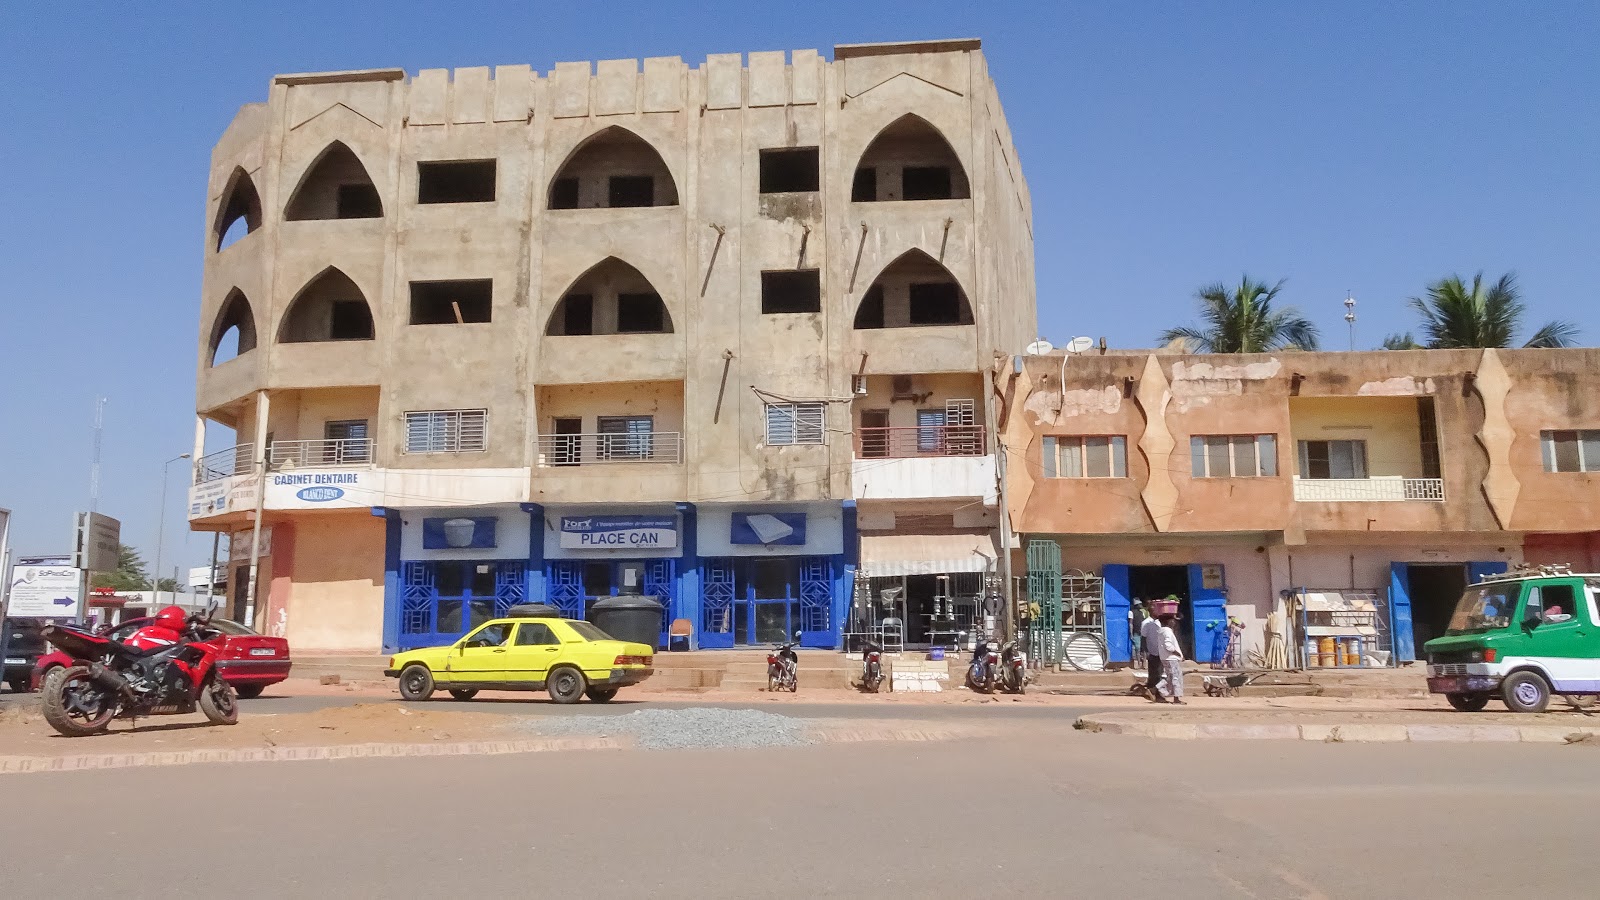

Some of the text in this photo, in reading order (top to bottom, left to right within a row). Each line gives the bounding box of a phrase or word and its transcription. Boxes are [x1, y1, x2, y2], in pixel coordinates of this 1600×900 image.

[274, 473, 358, 486] CABINET DENTAIRE
[581, 532, 658, 544] PLACE CAN
[150, 705, 178, 713] YAMAHA
